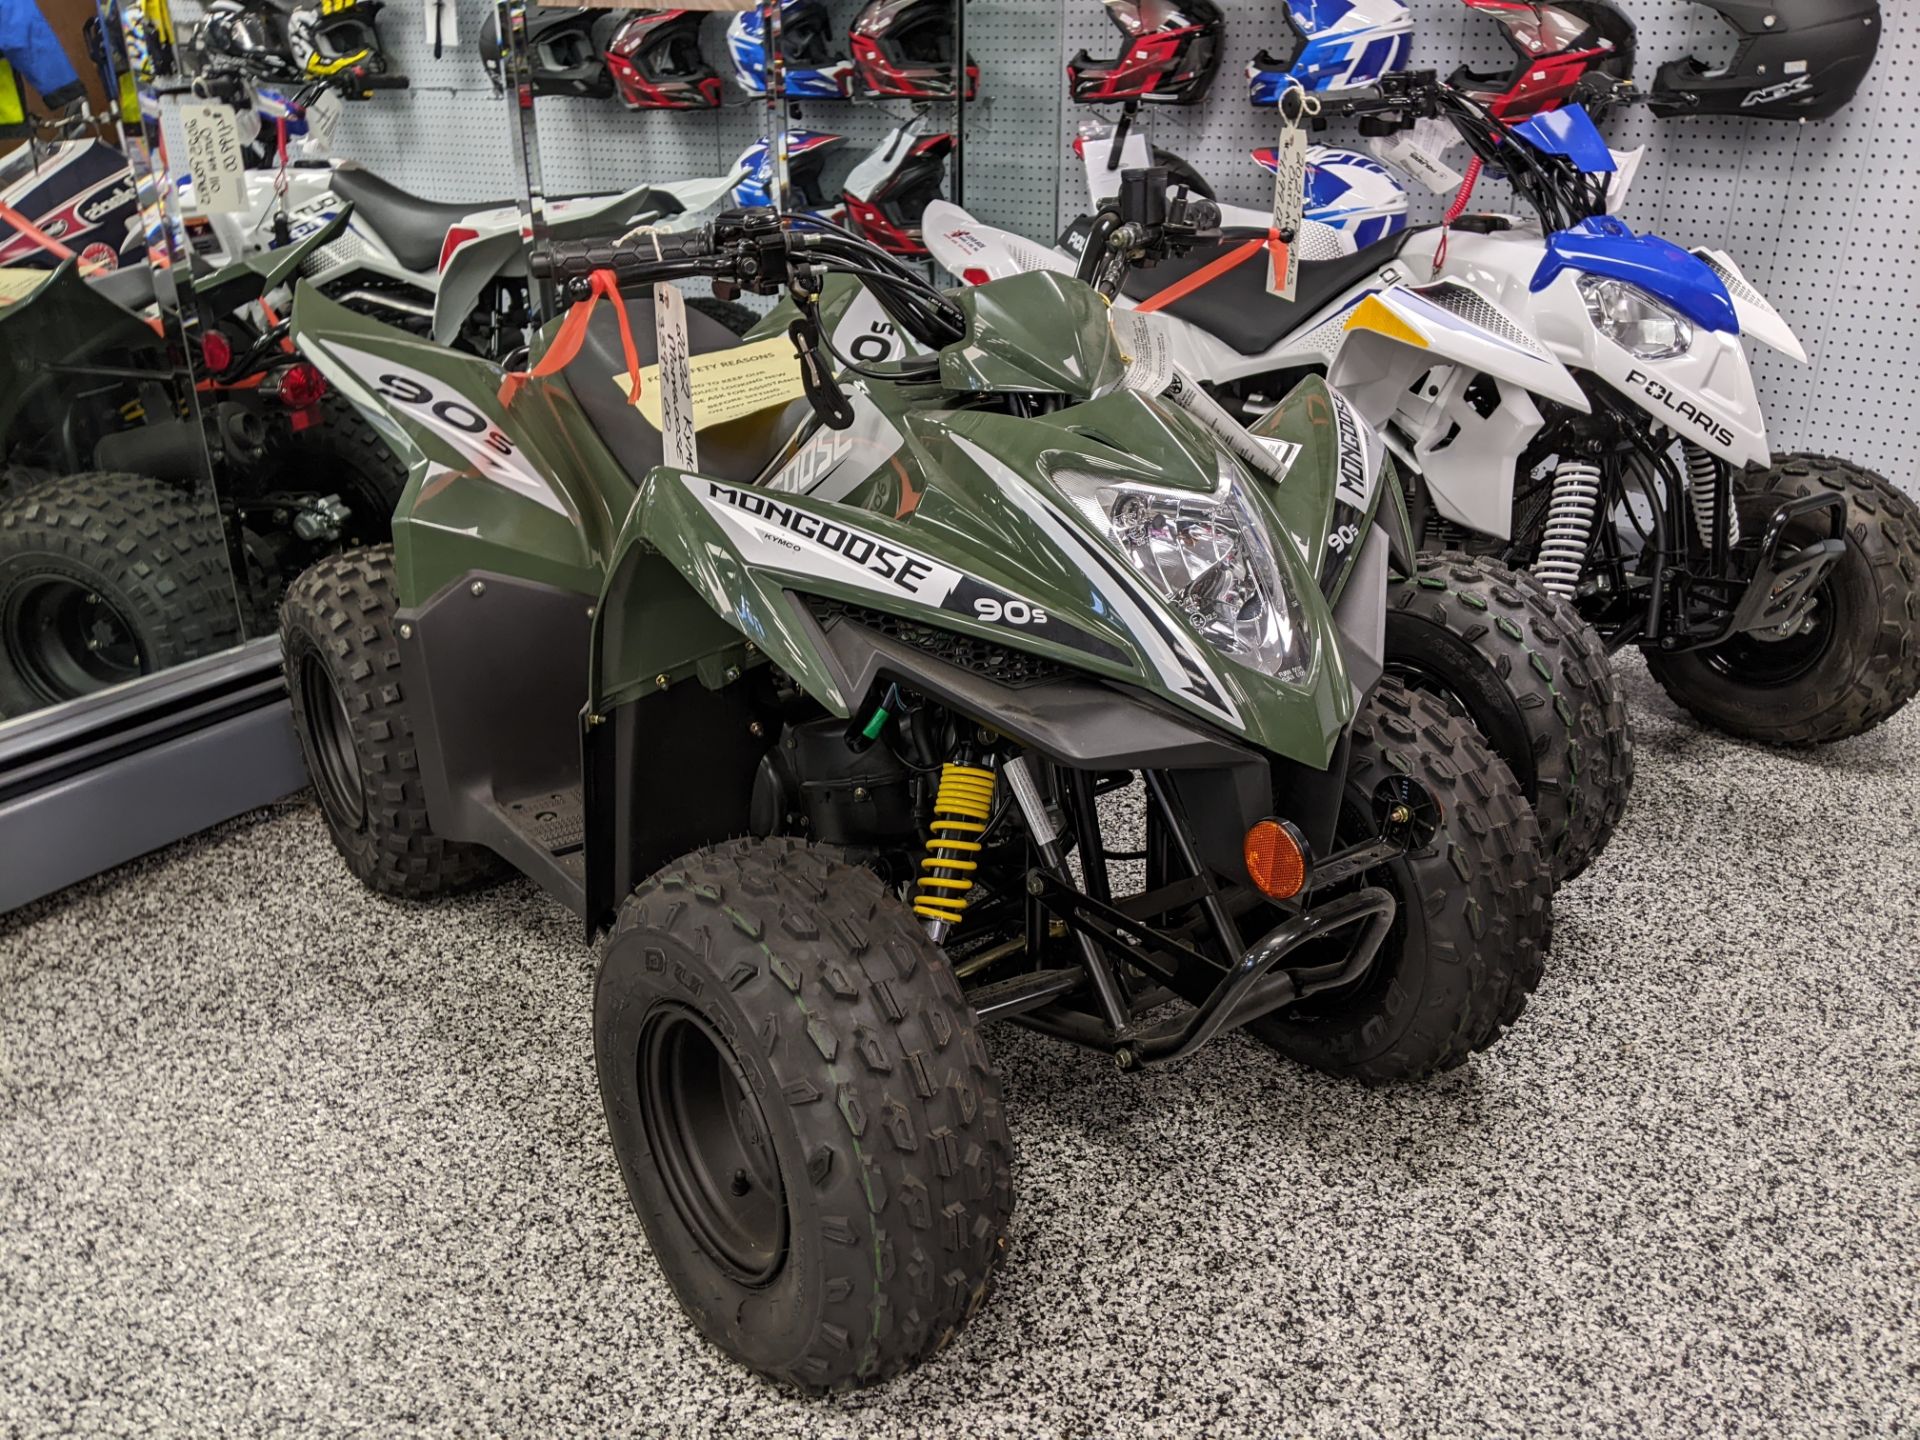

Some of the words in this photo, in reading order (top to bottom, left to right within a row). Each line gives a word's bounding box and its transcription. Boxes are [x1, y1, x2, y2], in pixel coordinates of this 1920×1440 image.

[1740, 74, 1813, 107] AFX
[1293, 152, 1304, 210] 2025
[690, 363, 717, 374] FETY
[720, 352, 775, 368] REASONS
[675, 323, 691, 399] 2022
[683, 416, 695, 472] KYMC
[1625, 369, 1735, 447] POLARIS
[1332, 390, 1365, 499] MONGOOSE
[708, 482, 933, 594] MONGOOSE
[764, 532, 802, 552] KYMCO
